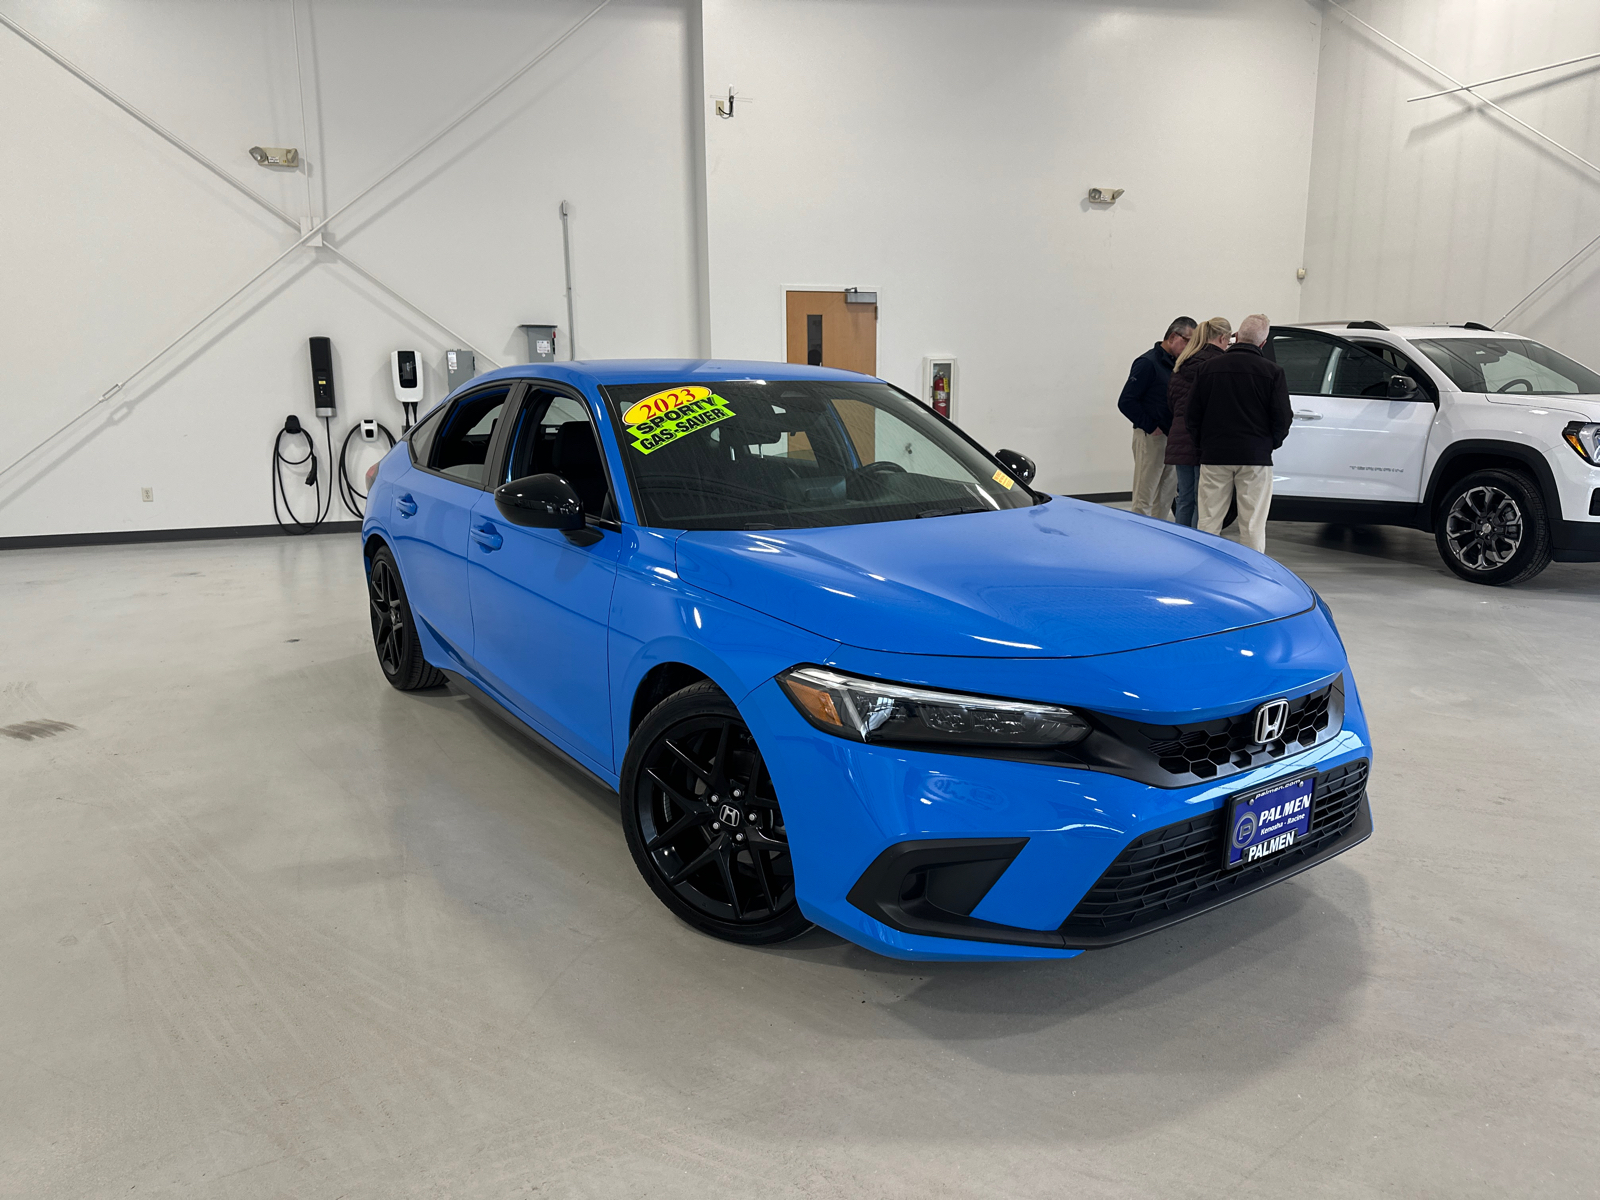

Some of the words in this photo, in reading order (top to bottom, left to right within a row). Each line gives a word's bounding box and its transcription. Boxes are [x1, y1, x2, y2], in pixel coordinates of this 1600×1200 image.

[636, 396, 716, 435] SPORTY
[640, 388, 696, 420] 2023
[640, 407, 726, 450] GAS-SAVER
[1258, 793, 1312, 826] PALMEN
[1260, 821, 1284, 836] Kenosha
[1287, 813, 1306, 825] Racine
[1247, 830, 1295, 862] PALMEN
